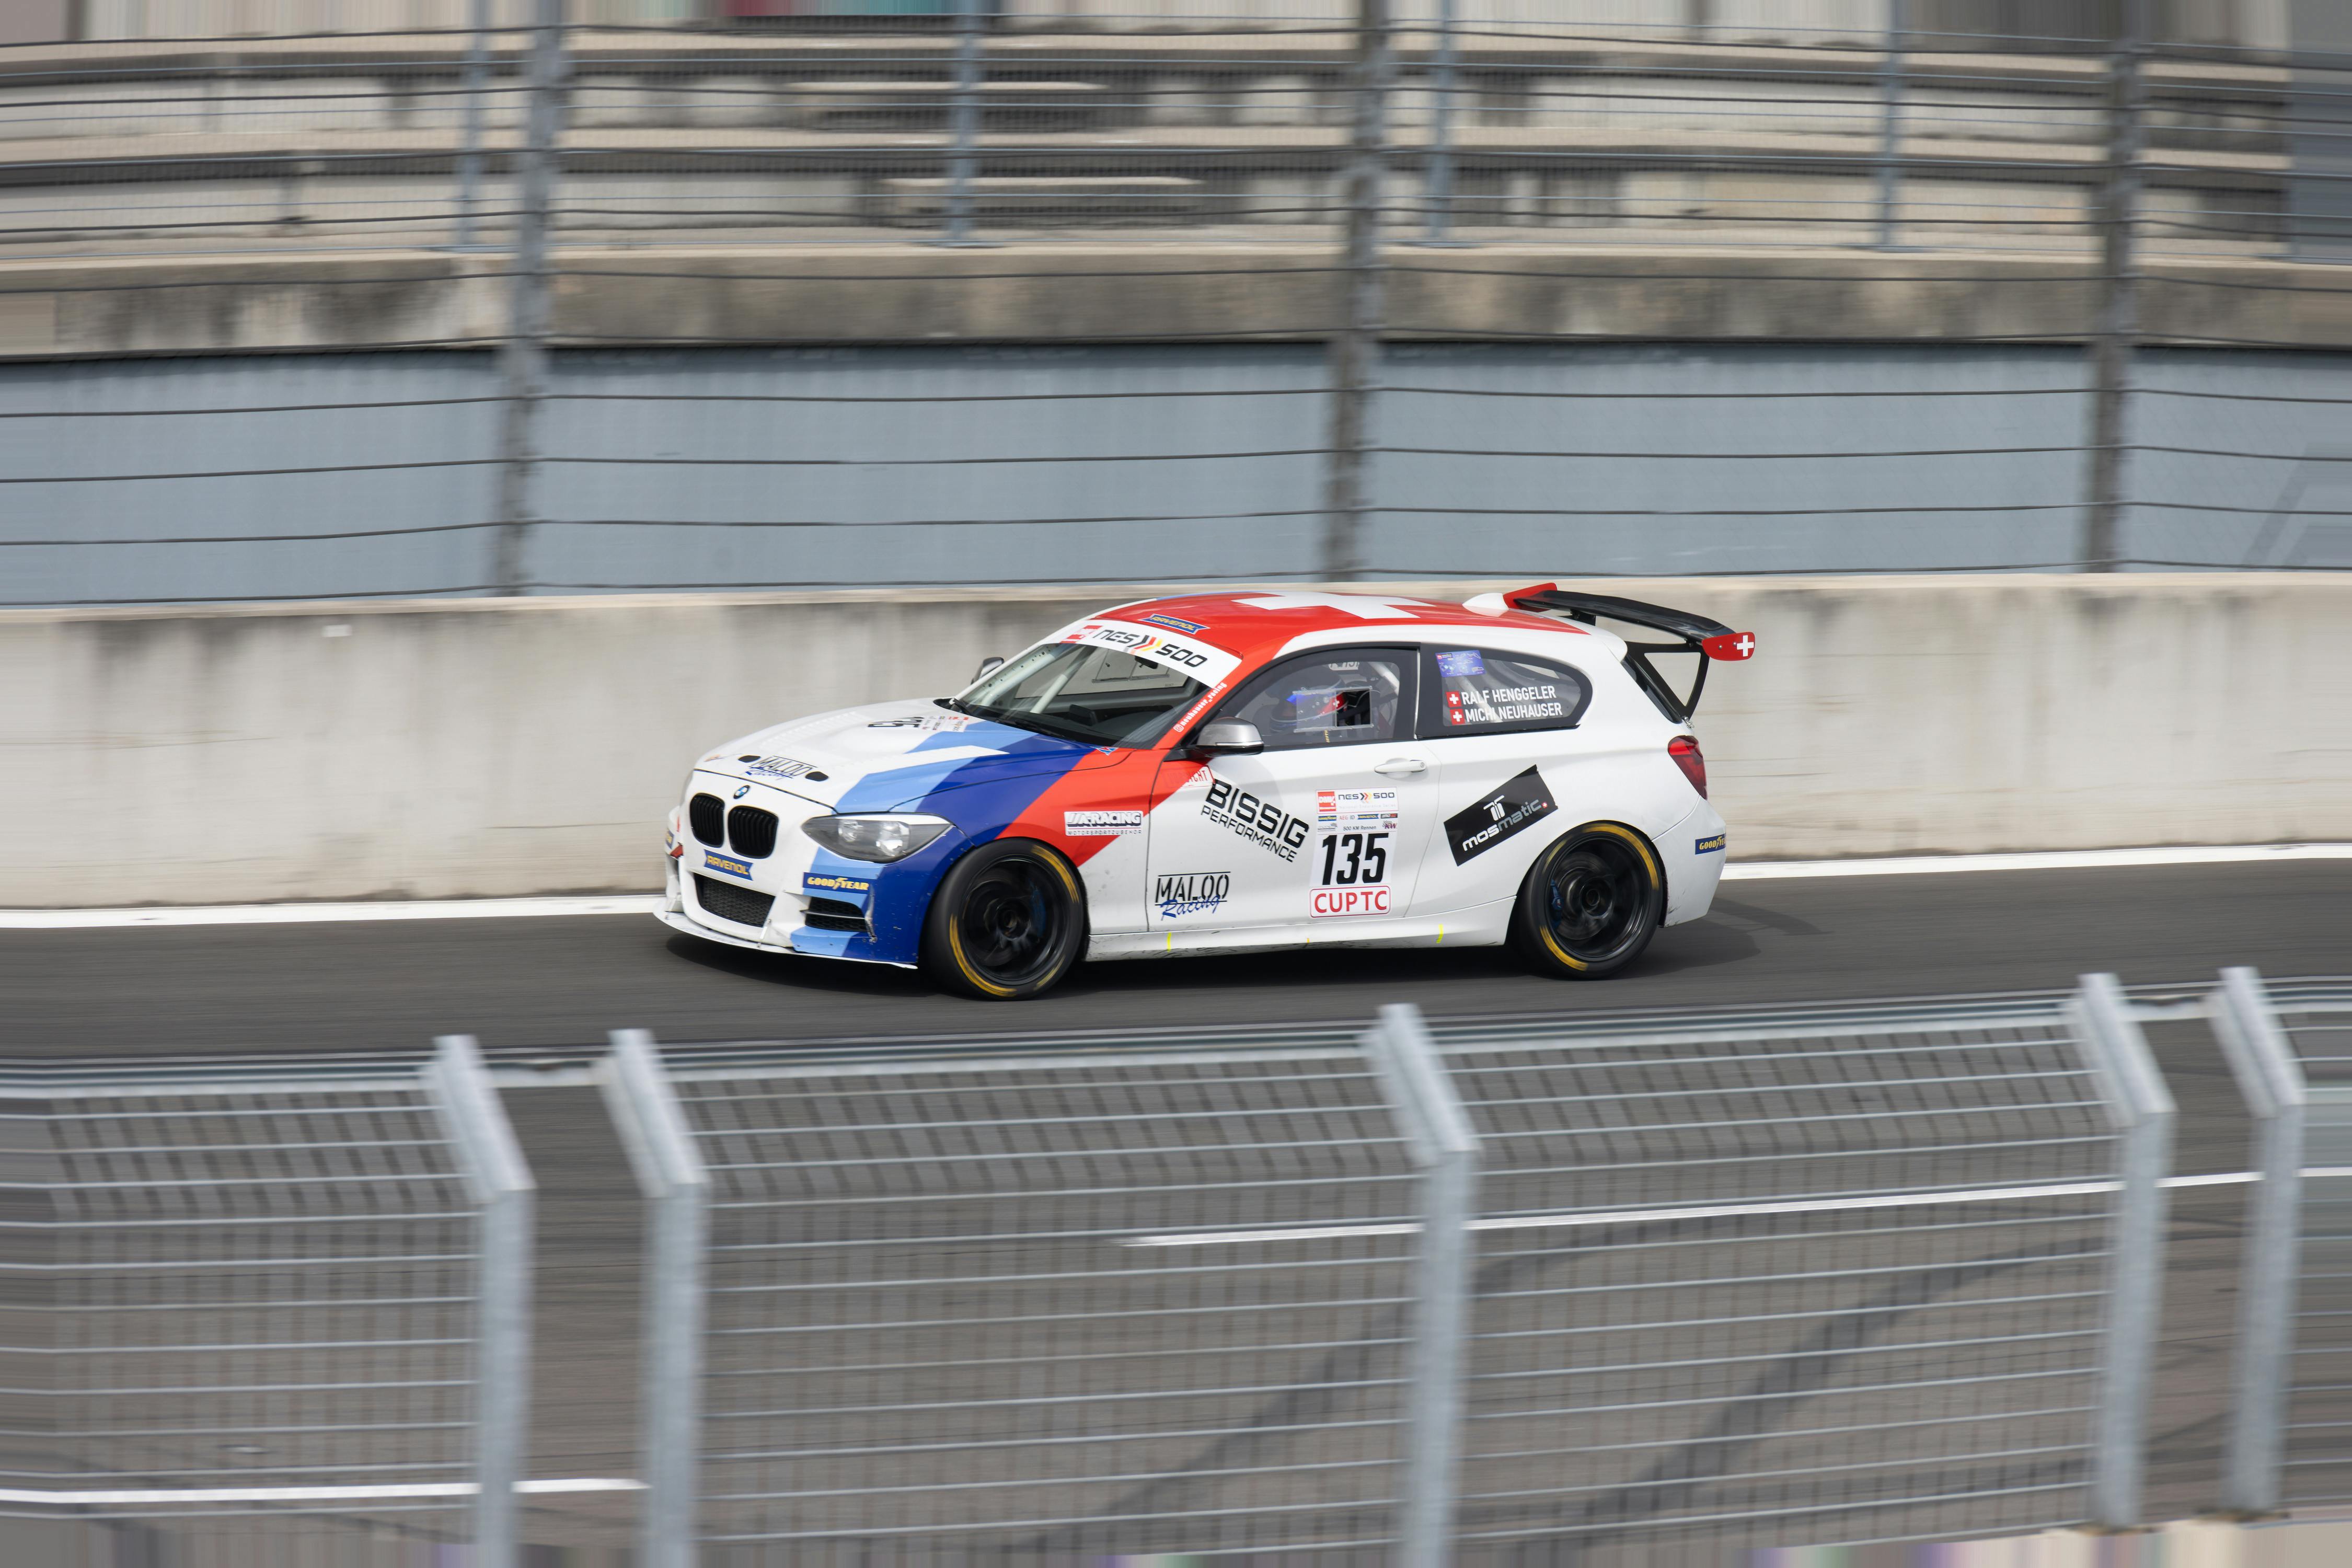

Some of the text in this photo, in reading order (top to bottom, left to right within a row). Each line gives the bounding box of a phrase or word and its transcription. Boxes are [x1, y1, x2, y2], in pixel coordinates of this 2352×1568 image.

[1150, 617, 1199, 631] RAVENOL
[1155, 643, 1208, 667] 500
[1461, 685, 1557, 705] RALF HENGGELER
[1464, 702, 1563, 722] MICHI NEUHAUSER
[751, 757, 813, 777] MALOO
[1205, 778, 1310, 848] BISSIG
[1201, 805, 1297, 863] PERFORMANCE
[1462, 799, 1542, 851] mosmatic
[707, 855, 749, 875] RAVENOL
[1322, 833, 1389, 885] 135
[807, 877, 870, 891] GOODYEAR
[1155, 874, 1229, 903] MALOO
[1159, 894, 1221, 921] Racing
[1315, 890, 1387, 913] CUP TC
